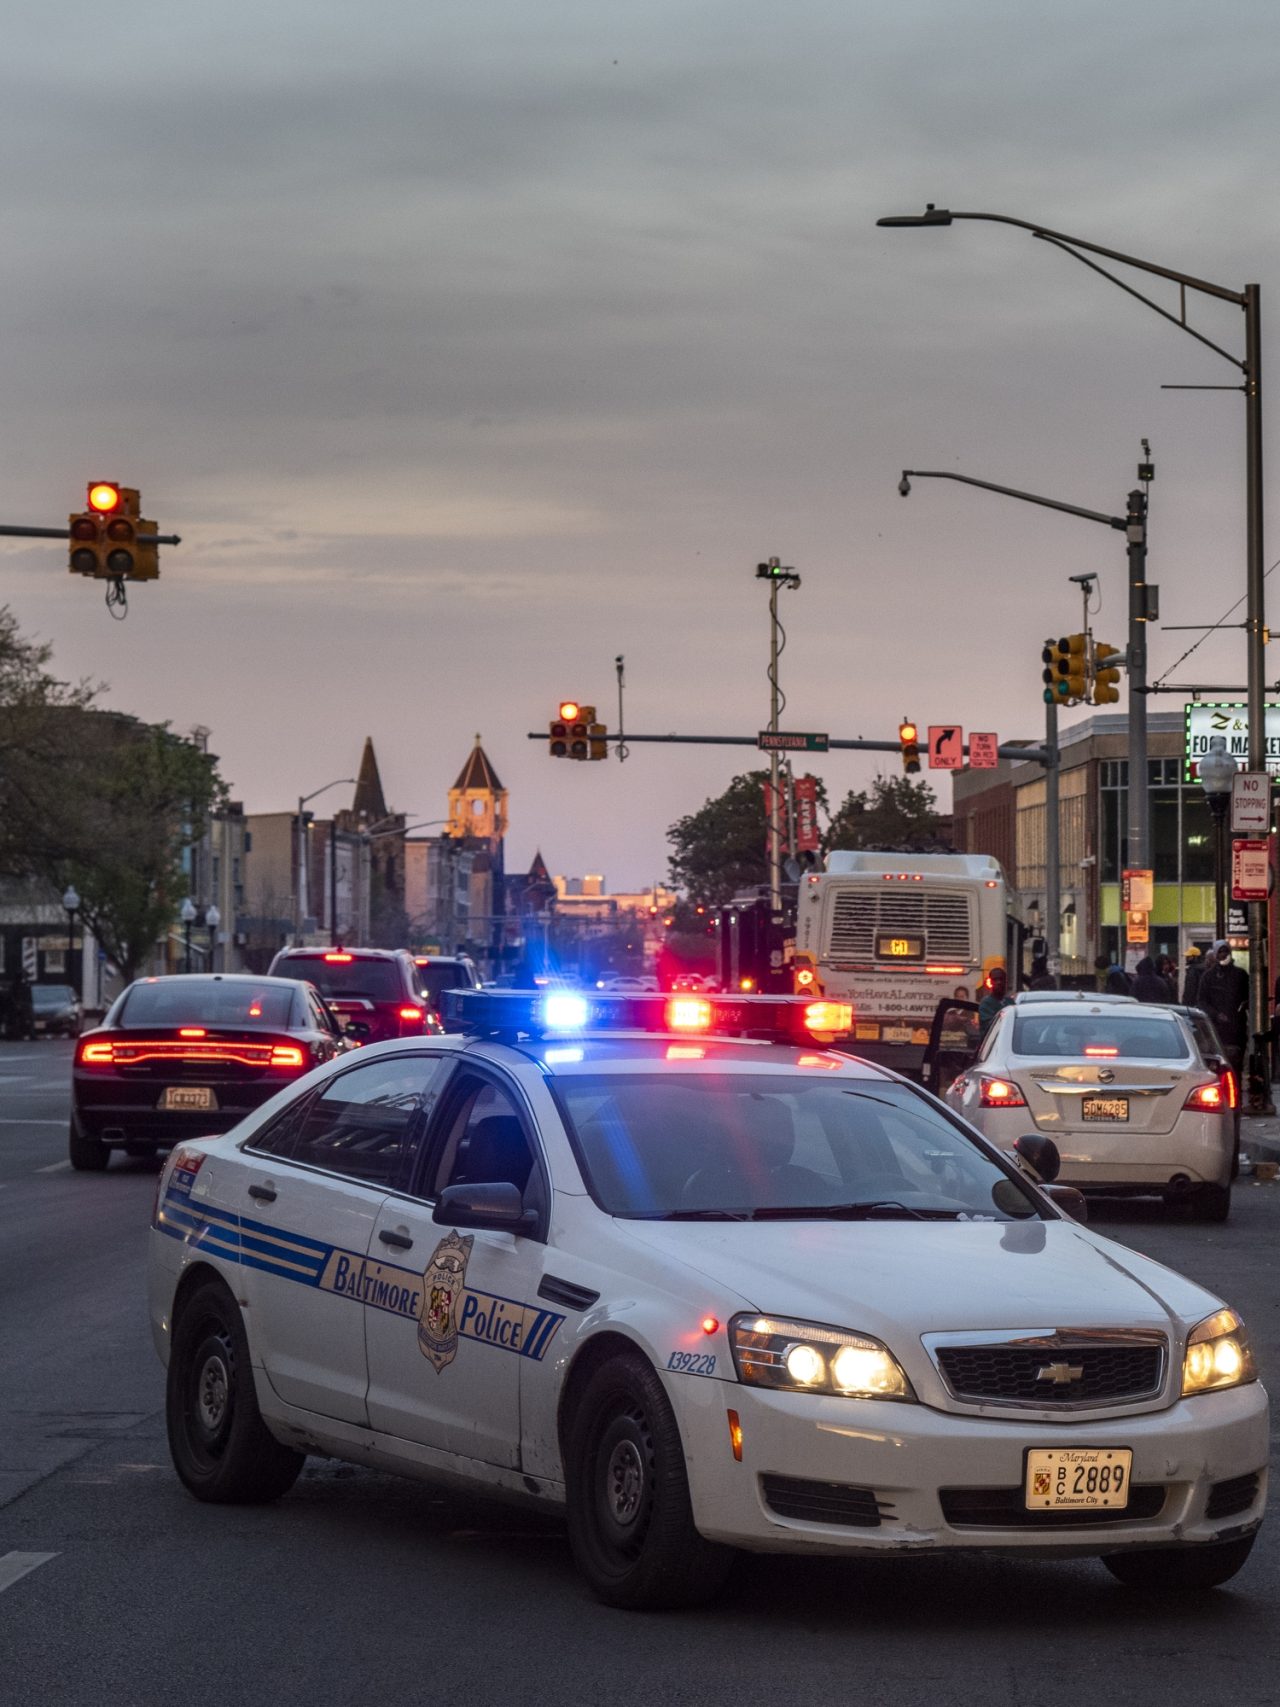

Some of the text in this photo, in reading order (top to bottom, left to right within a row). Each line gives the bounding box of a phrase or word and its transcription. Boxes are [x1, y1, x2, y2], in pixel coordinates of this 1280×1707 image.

[1211, 712, 1243, 731] Z &
[762, 735, 807, 748] PENNSYLVANIA
[934, 757, 956, 765] ONLY
[1243, 780, 1258, 792] NO
[1235, 797, 1266, 810] STOPPING
[433, 1273, 456, 1288] POLICE
[667, 1351, 716, 1375] 139228
[1060, 1452, 1099, 1463] Maryland
[1073, 1464, 1124, 1494] 2889
[1055, 1495, 1098, 1505] Baltimore City
